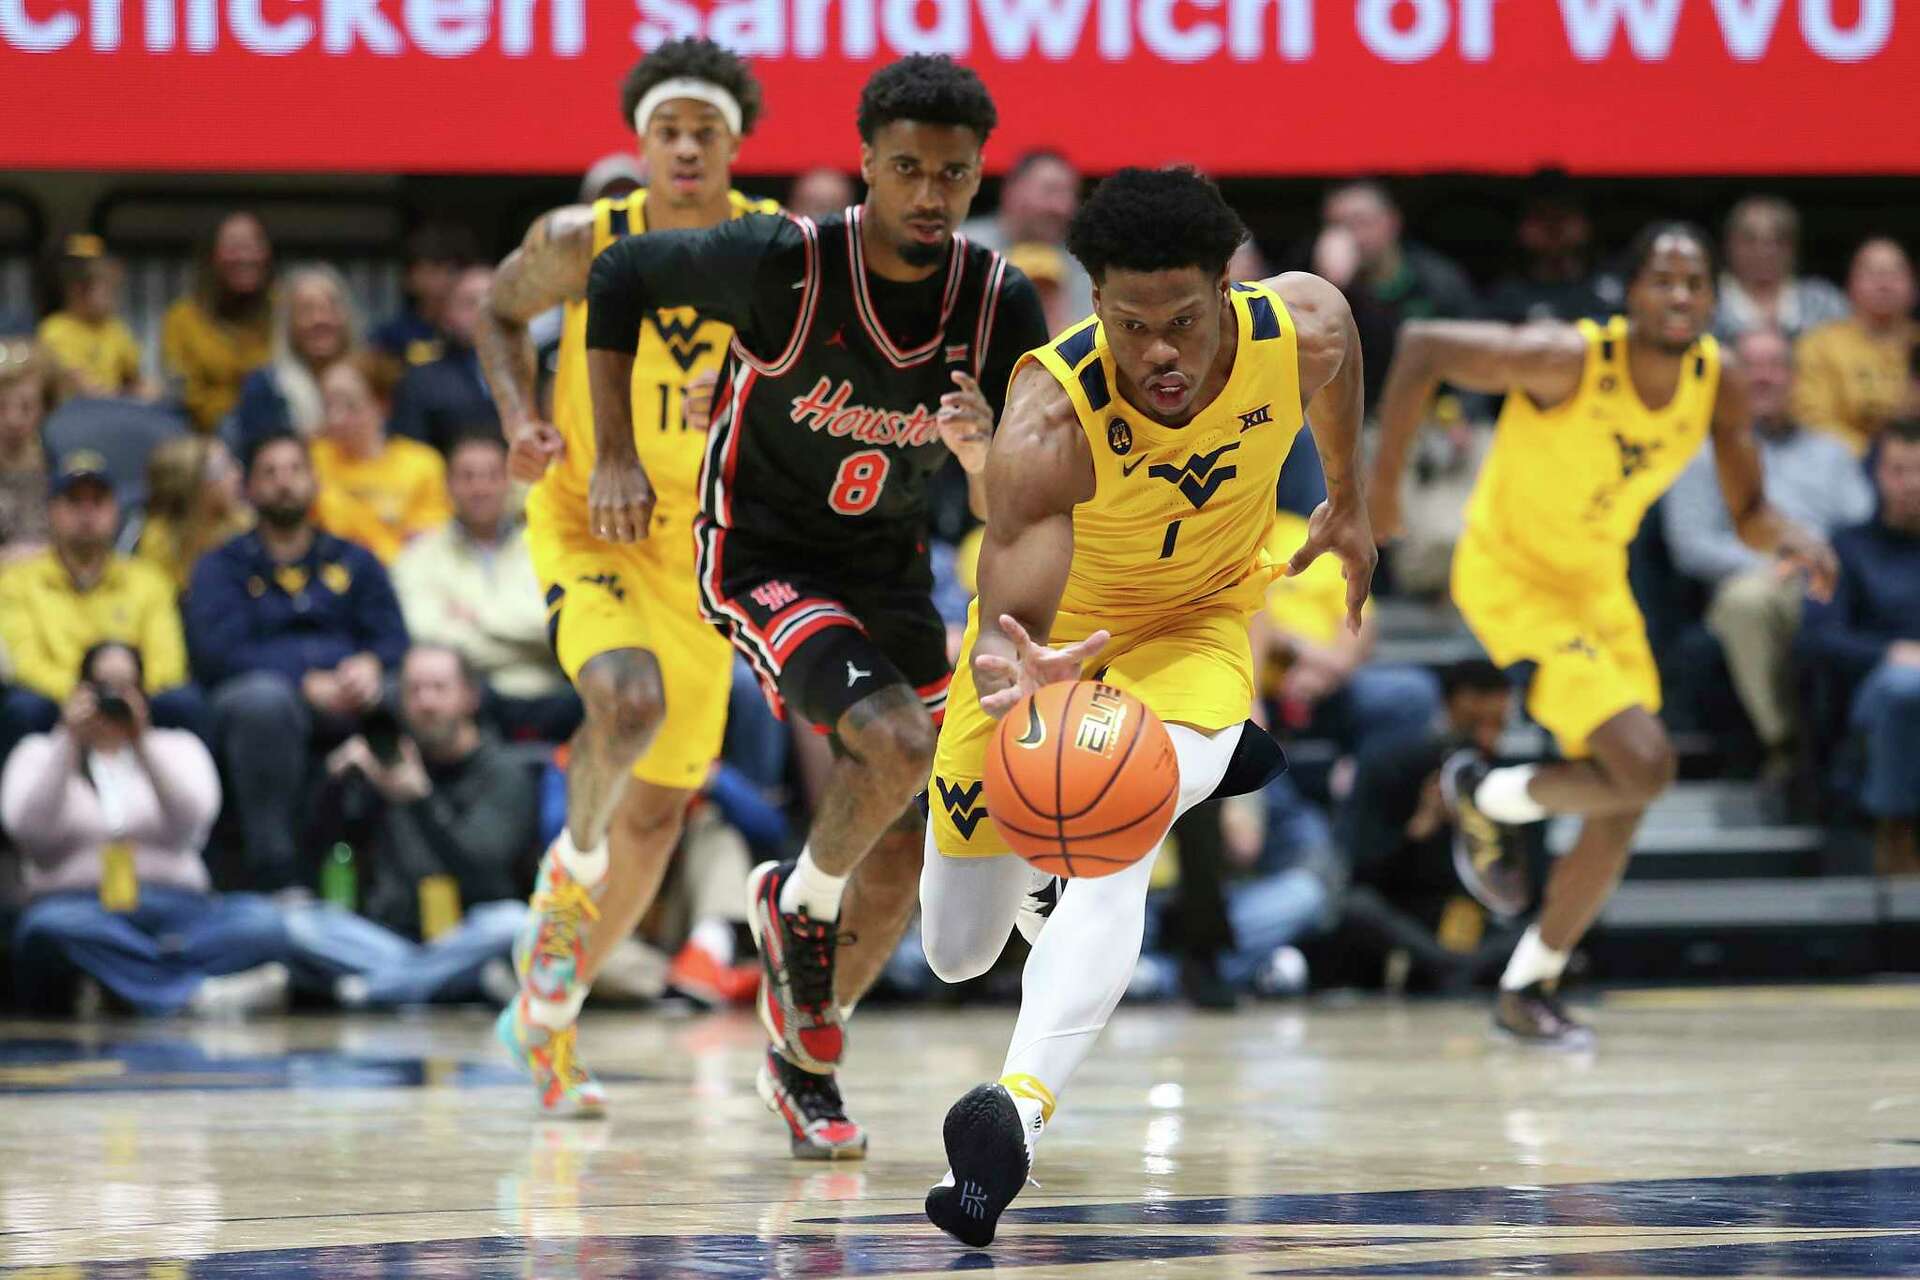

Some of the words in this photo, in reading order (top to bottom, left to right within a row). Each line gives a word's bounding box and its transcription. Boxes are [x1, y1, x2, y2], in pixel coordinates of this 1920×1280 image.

[1557, 0, 1897, 63] WVU
[789, 374, 941, 448] Housto
[828, 449, 890, 516] 8
[1158, 519, 1182, 560] 1
